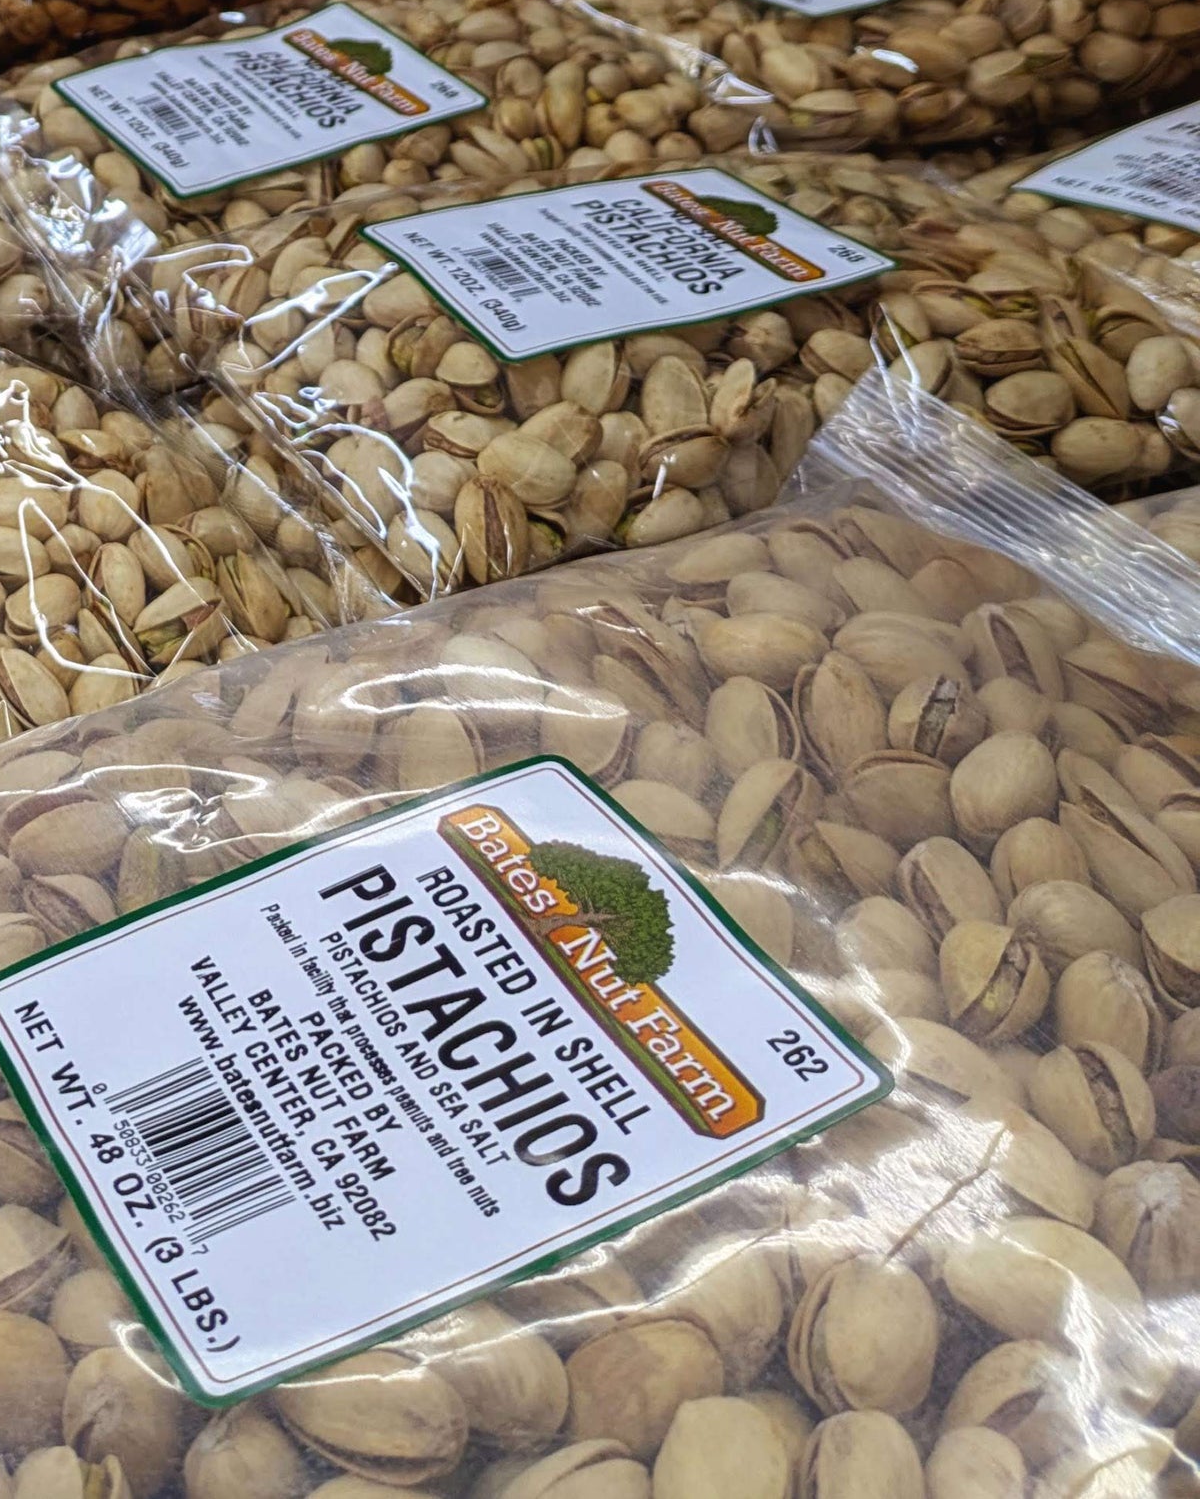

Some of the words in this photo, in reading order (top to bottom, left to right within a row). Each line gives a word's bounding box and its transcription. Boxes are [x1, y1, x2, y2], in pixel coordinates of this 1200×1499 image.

[87, 84, 115, 101] NET
[224, 51, 347, 129] PISTACHIOS
[256, 51, 364, 115] CALIFORNIA
[291, 32, 339, 65] Bates
[342, 59, 382, 88] Nut
[366, 81, 419, 114] Farm
[486, 221, 523, 244] VALLEY
[552, 273, 571, 286] CA
[519, 231, 552, 251] BATES
[549, 250, 576, 267] NUT
[568, 266, 604, 290] FARM
[550, 237, 596, 266] PACKED
[585, 264, 610, 277] BY
[573, 199, 724, 296] PISTACHIOS
[610, 199, 747, 282] CALIFORNIA
[651, 181, 715, 223] Bates
[710, 217, 758, 245] Nut
[748, 239, 811, 281] Farm
[827, 243, 868, 264] 268
[402, 230, 437, 249] NET
[426, 247, 456, 269] WT.
[478, 297, 529, 333] (340g)
[259, 902, 302, 945] Packed
[288, 941, 315, 959] in
[298, 954, 338, 999] facility
[415, 865, 538, 996] ROASTED
[519, 996, 575, 1039] IN
[554, 1036, 652, 1137] SHELL
[458, 813, 558, 916] Bates
[558, 926, 646, 1013] Nut
[625, 1004, 737, 1123] Farm
[317, 862, 632, 1207] PISTACHIOS
[326, 995, 358, 1026] that
[298, 1010, 374, 1101] PACKED
[361, 1102, 403, 1134] BY
[318, 930, 409, 1038] PISTACHIOS
[394, 1039, 441, 1082] AND
[428, 1080, 470, 1121] SEA
[458, 1117, 512, 1167] SALT
[340, 1023, 398, 1087] processes
[765, 1028, 831, 1084] 262
[177, 994, 347, 1232] www.batesnutfarm.biz
[189, 954, 258, 1035] VALLEY
[243, 1040, 317, 1138] CENTER,
[310, 1137, 346, 1173] CA
[334, 1171, 397, 1242] 92082
[247, 988, 309, 1063] BATES
[296, 1063, 347, 1113] NUT
[332, 1114, 398, 1182] FARM
[382, 1084, 436, 1135] peanuts
[13, 1000, 65, 1053] NET
[51, 1061, 97, 1126] WT.
[89, 1132, 125, 1164] 48
[112, 1172, 158, 1229] OZ.
[144, 1236, 185, 1264] (3
[171, 1268, 241, 1353] LBS.)
[426, 1130, 461, 1159] and
[445, 1154, 477, 1187] tree
[113, 1118, 153, 1167] 50833
[145, 1171, 186, 1224] 00262
[191, 1243, 210, 1257] 7
[466, 1184, 502, 1219] nuts
